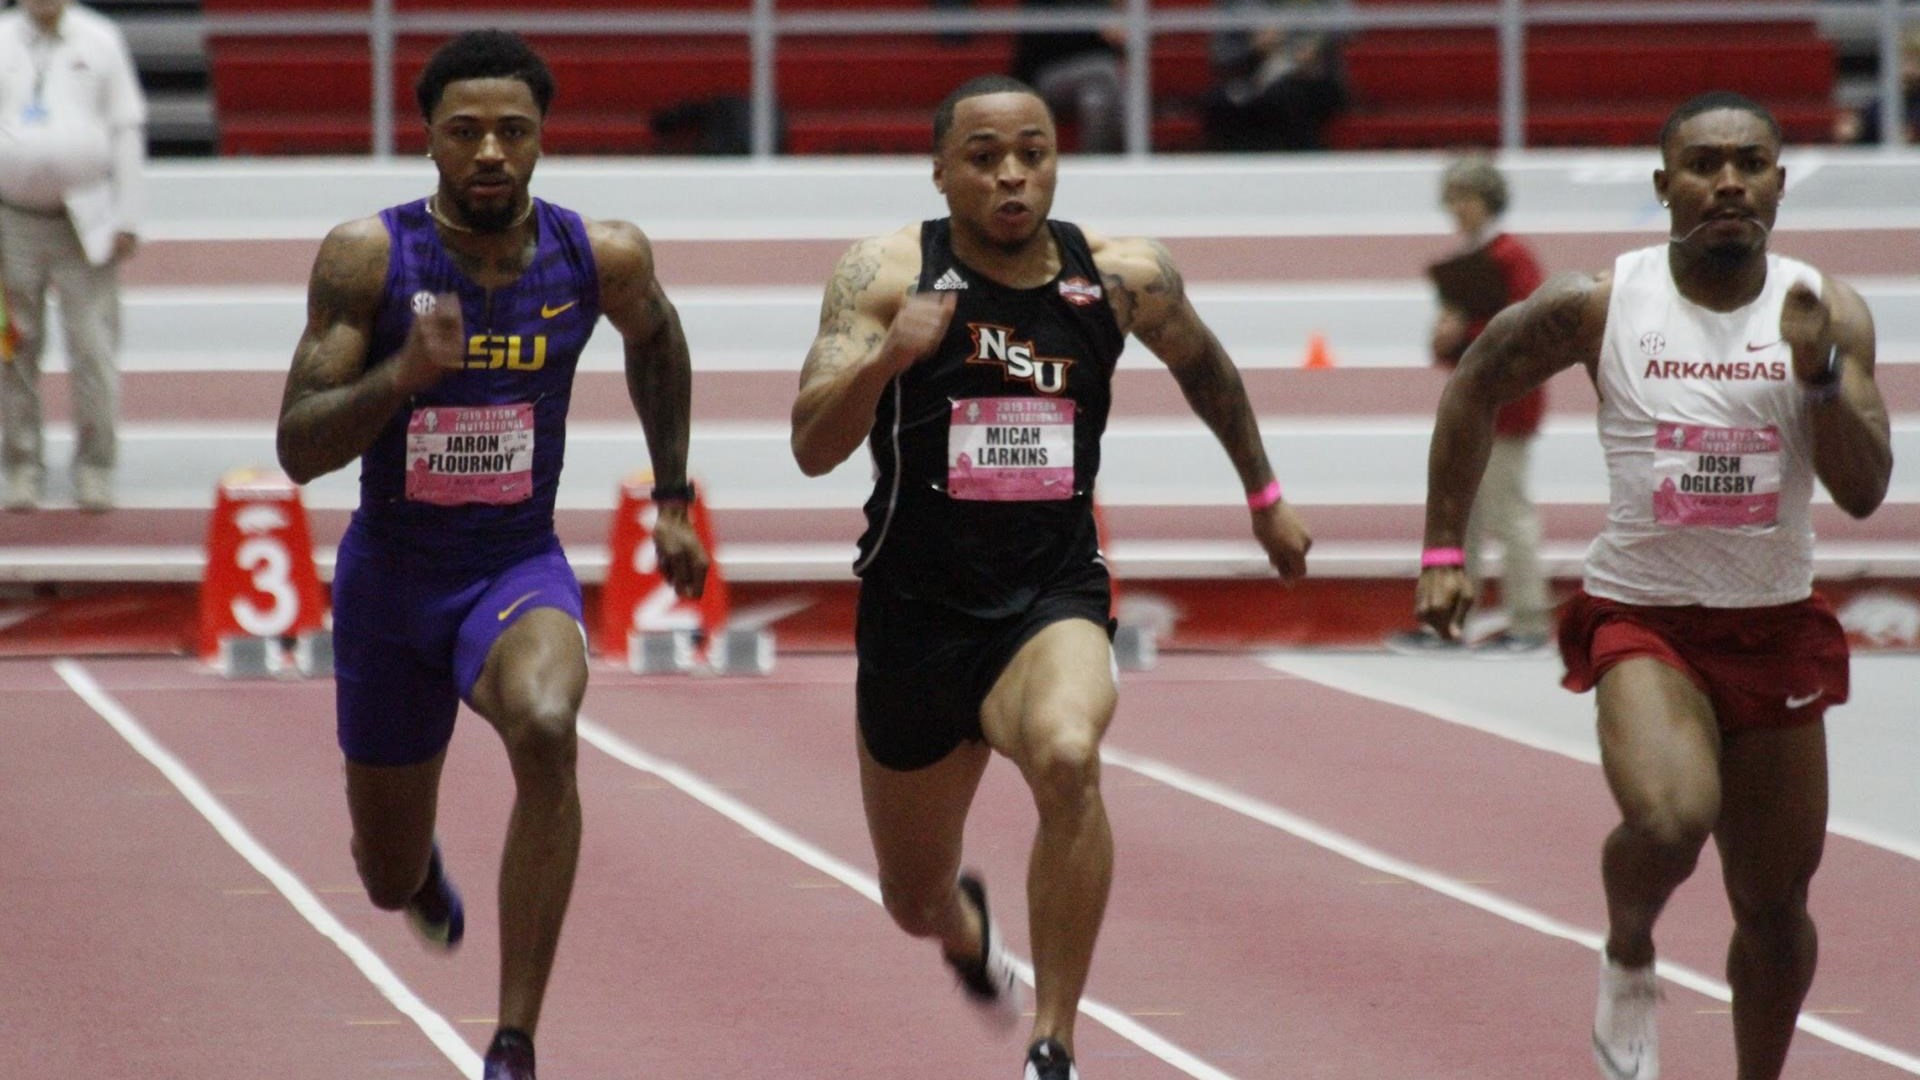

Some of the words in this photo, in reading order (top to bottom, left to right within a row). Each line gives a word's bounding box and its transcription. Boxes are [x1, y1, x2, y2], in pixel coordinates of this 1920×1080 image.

[934, 280, 969, 290] adidas
[460, 335, 547, 371] SU
[978, 327, 1064, 394] NSU
[1643, 359, 1786, 381] ARKANSAS
[455, 419, 524, 432] INVITATIONAL
[446, 435, 499, 453] JARON
[986, 427, 1041, 445] MICAH
[429, 453, 515, 473] FLOURNOY
[978, 447, 1048, 466] LARKINS
[1698, 455, 1741, 473] JOSH
[1680, 473, 1756, 493] OGLESBY
[230, 535, 299, 637] 3
